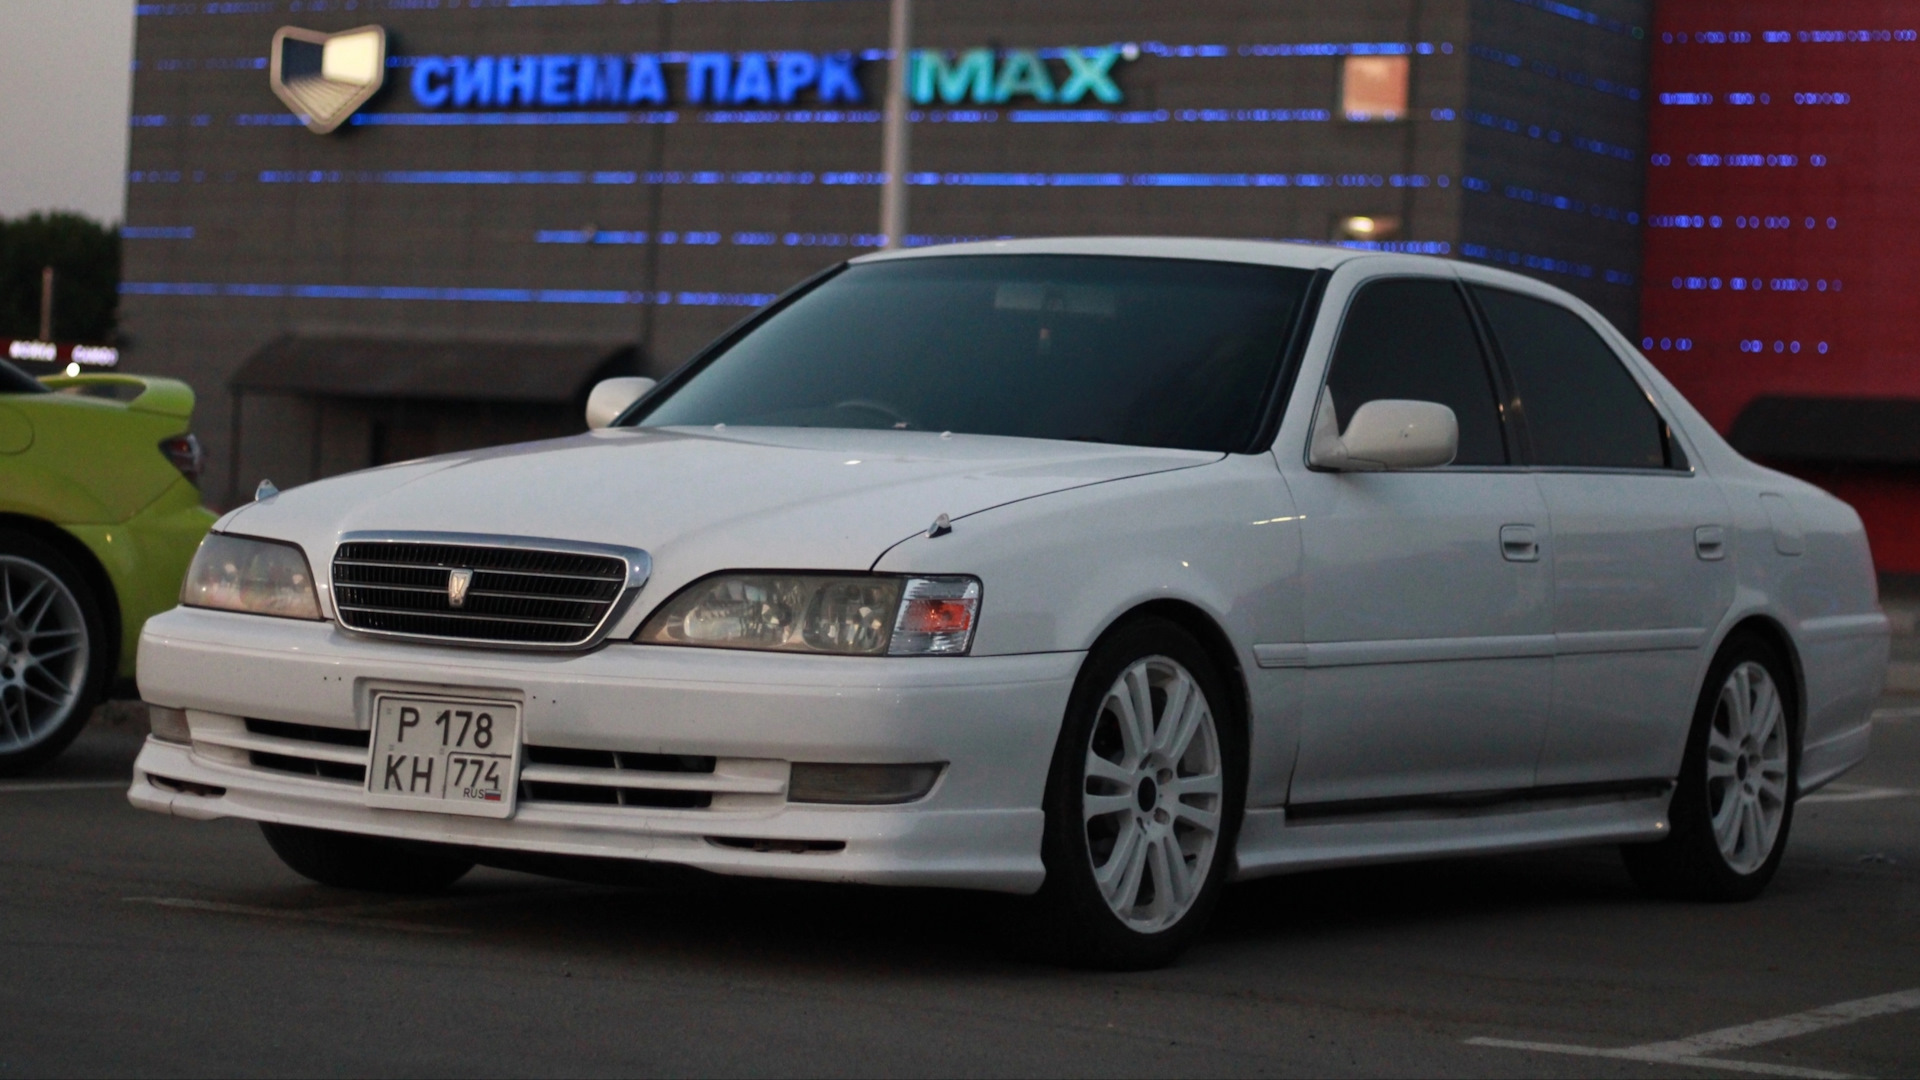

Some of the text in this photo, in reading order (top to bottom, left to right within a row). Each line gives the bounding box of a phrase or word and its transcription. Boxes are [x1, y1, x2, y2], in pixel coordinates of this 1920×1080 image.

[410, 51, 864, 107] СИНЕМА ПАРК
[435, 709, 494, 749] 178
[453, 757, 500, 790] 774
[463, 787, 485, 800] RUS
